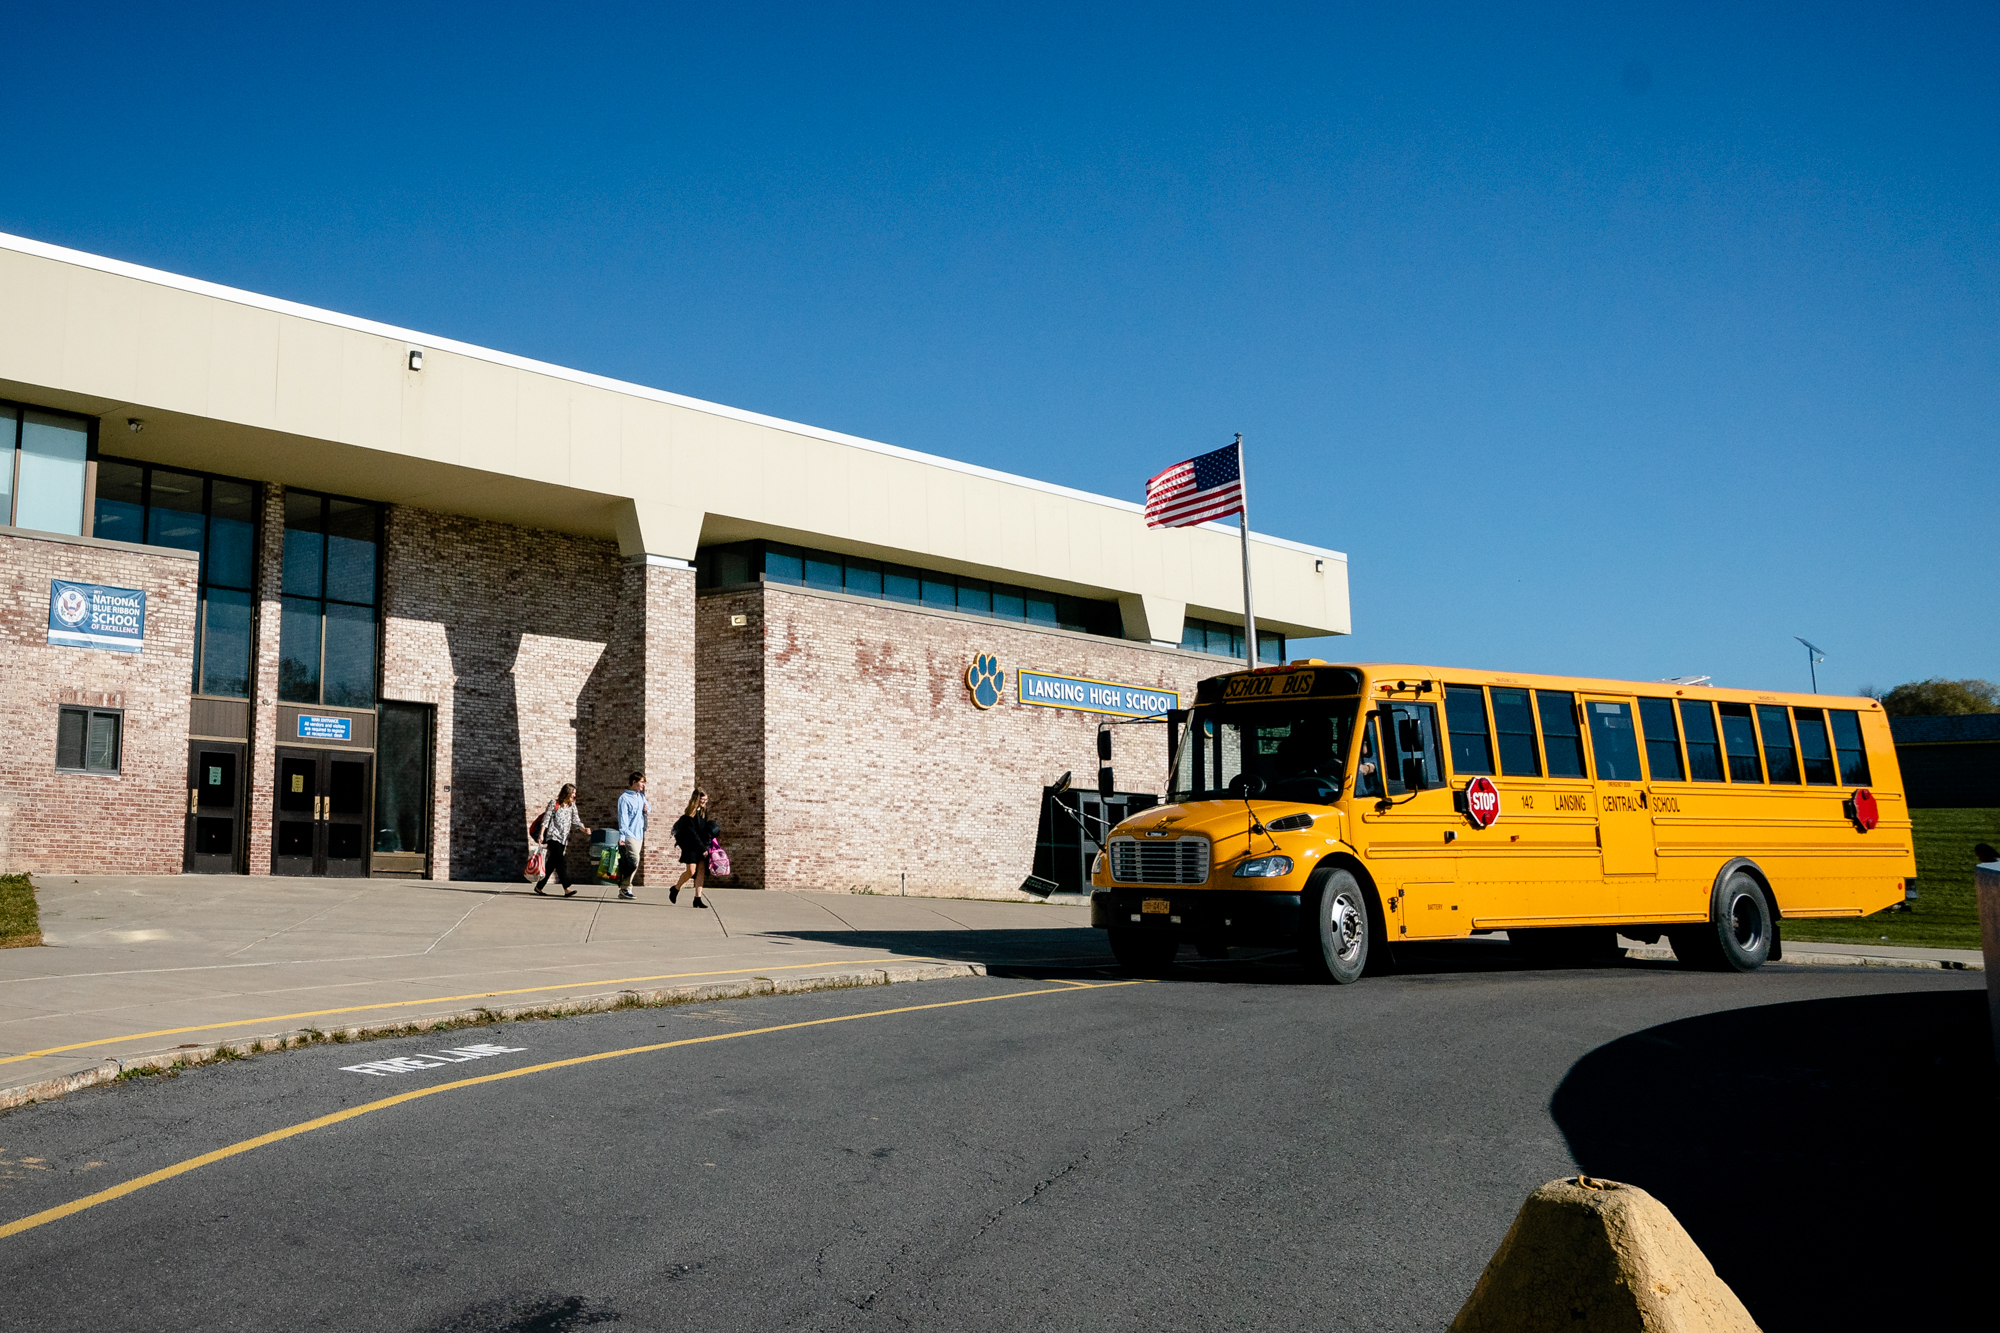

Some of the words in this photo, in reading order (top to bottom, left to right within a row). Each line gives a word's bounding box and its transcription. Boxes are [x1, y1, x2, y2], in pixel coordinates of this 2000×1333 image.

[92, 595, 140, 608] NATIONAL
[92, 604, 111, 613] BLUE
[112, 606, 140, 616] RIBBON
[91, 612, 139, 627] SCHOOL
[101, 625, 139, 634] EXCELLENCE
[1028, 679, 1084, 702] LANSING
[1089, 687, 1121, 707] HIGH
[1225, 676, 1274, 697] SCHOOL
[1281, 674, 1313, 694] BUS
[1472, 792, 1496, 811] STOP
[1521, 795, 1534, 809] 142
[1554, 795, 1586, 811] LANSING
[1602, 796, 1637, 812] CENTRAL
[1652, 797, 1680, 812] SCHOOL
[338, 1057, 446, 1076] FIRE
[415, 1044, 528, 1063] LANE
